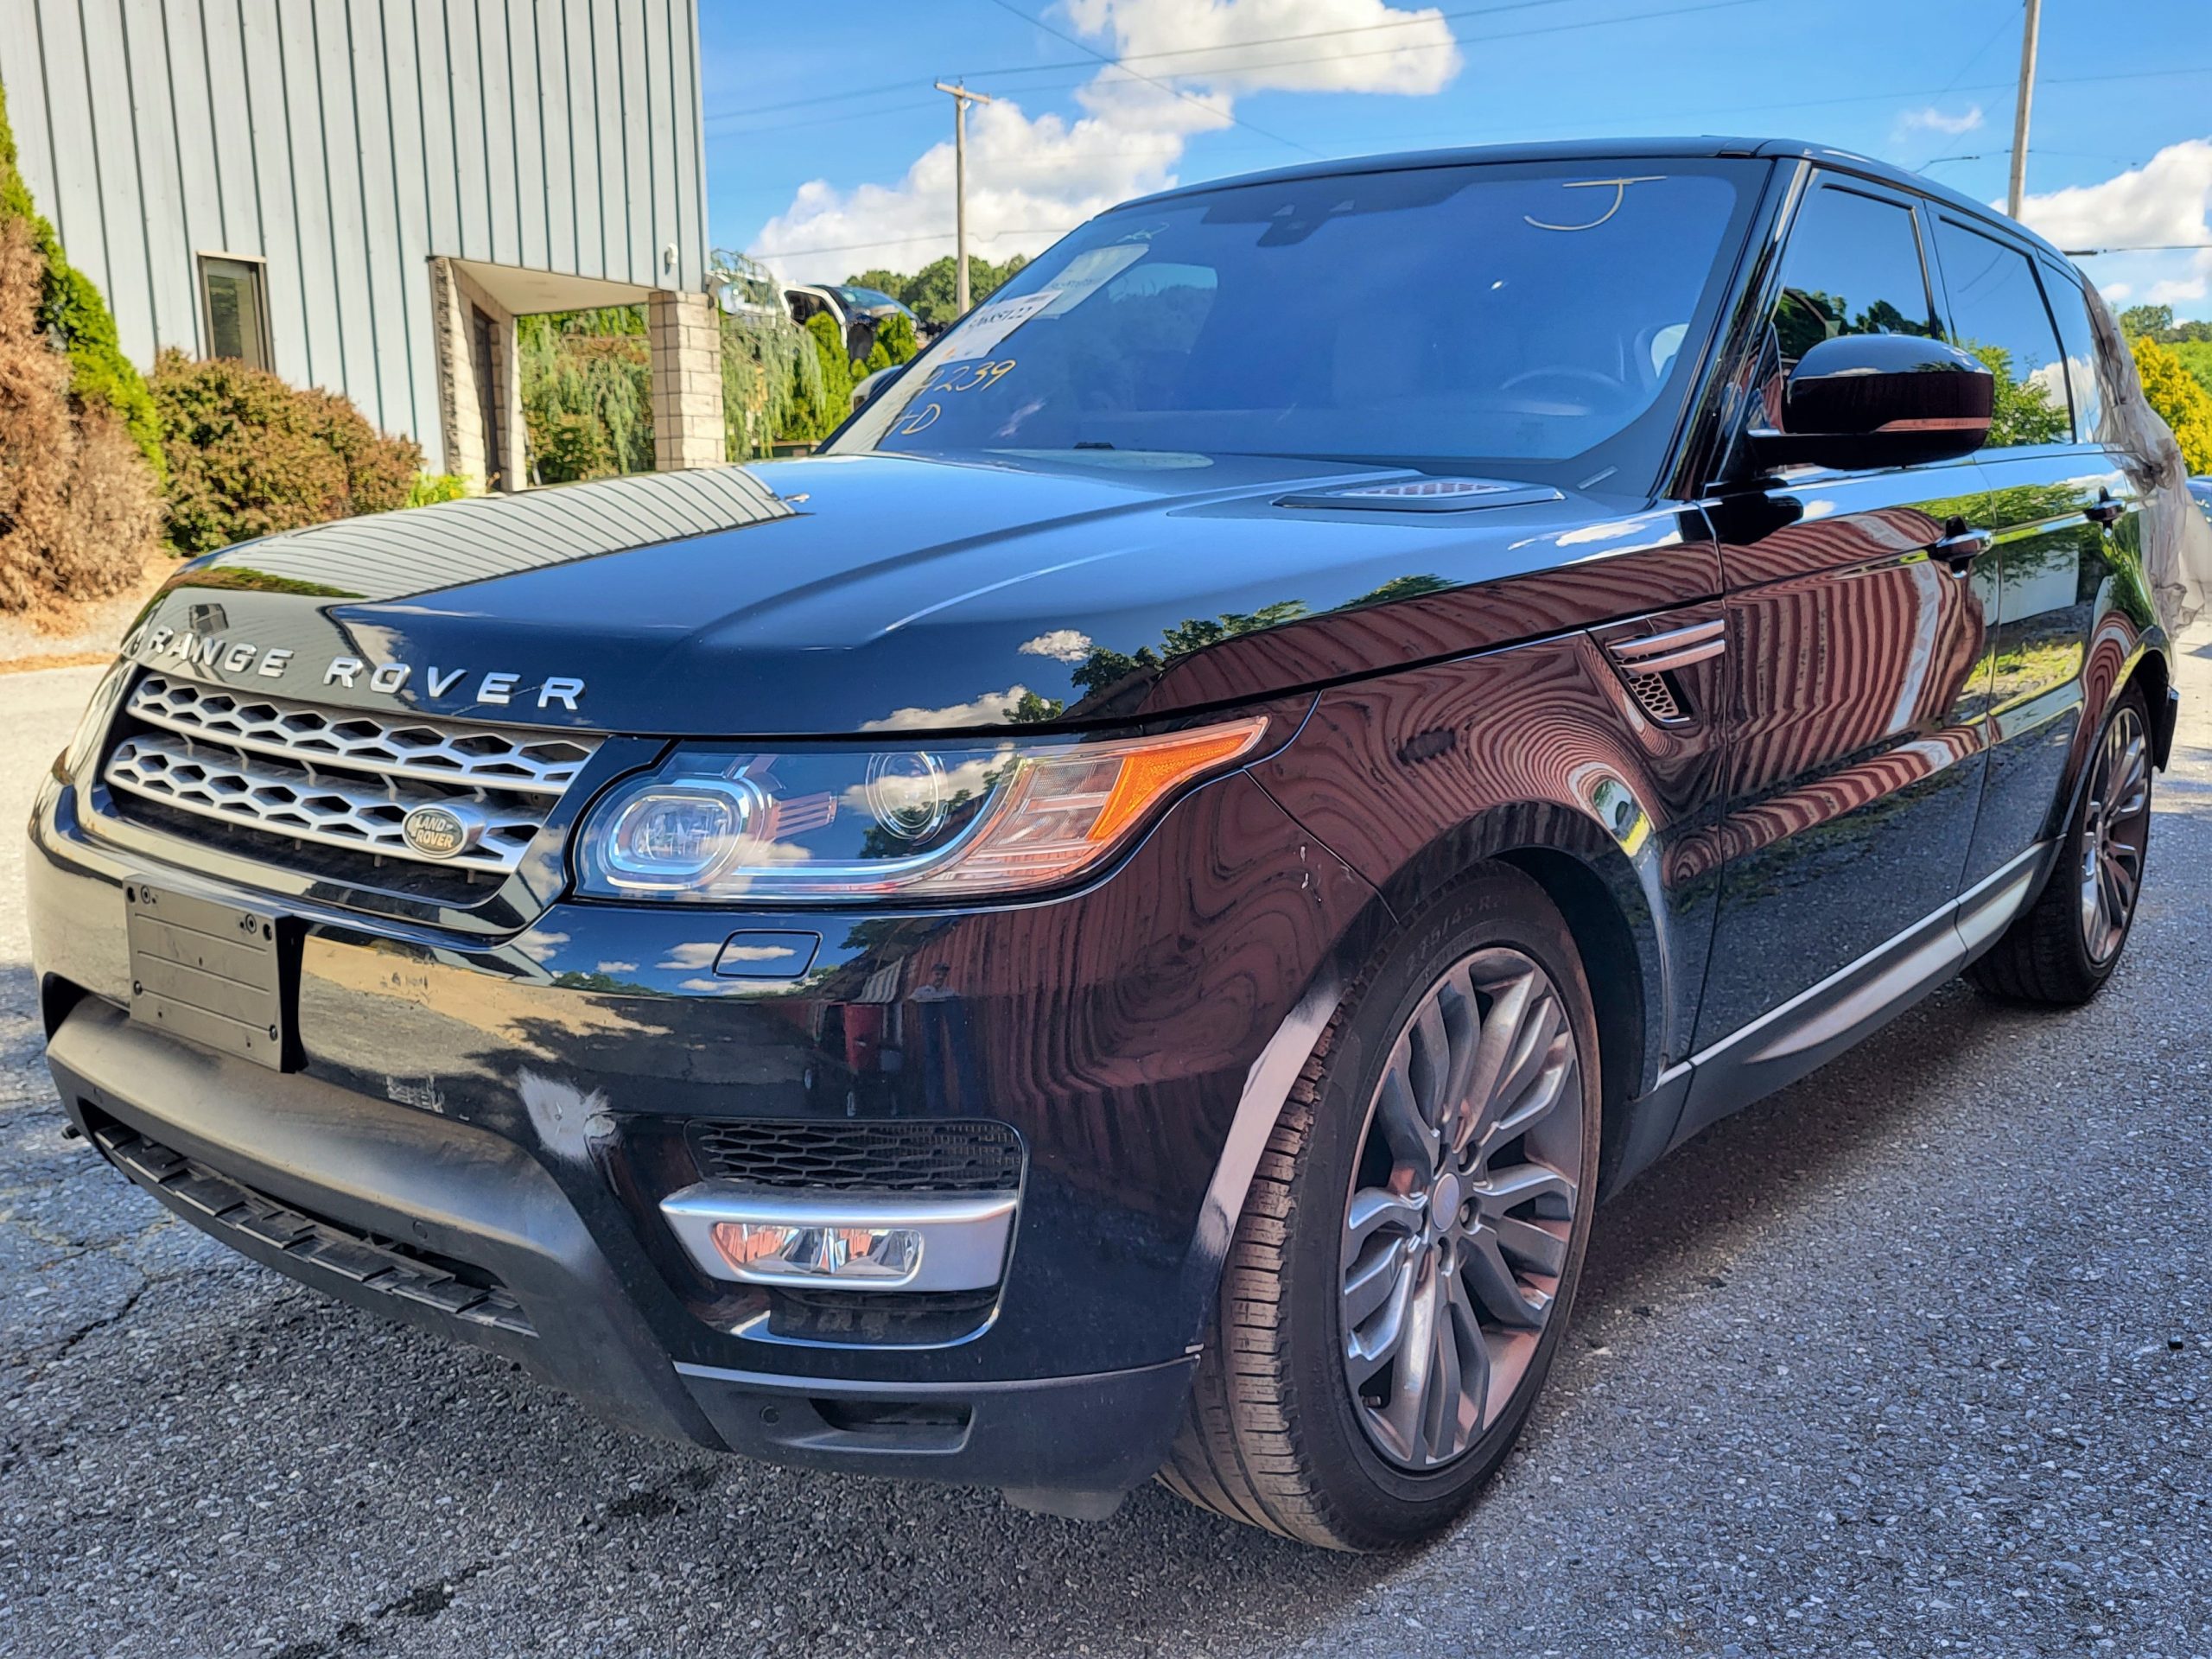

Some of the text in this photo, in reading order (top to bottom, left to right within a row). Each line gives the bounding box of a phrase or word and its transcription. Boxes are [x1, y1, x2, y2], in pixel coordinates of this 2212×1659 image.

[149, 625, 587, 711] RANGE ROVER
[415, 814, 448, 832] LAND
[416, 830, 455, 849] ROVER
